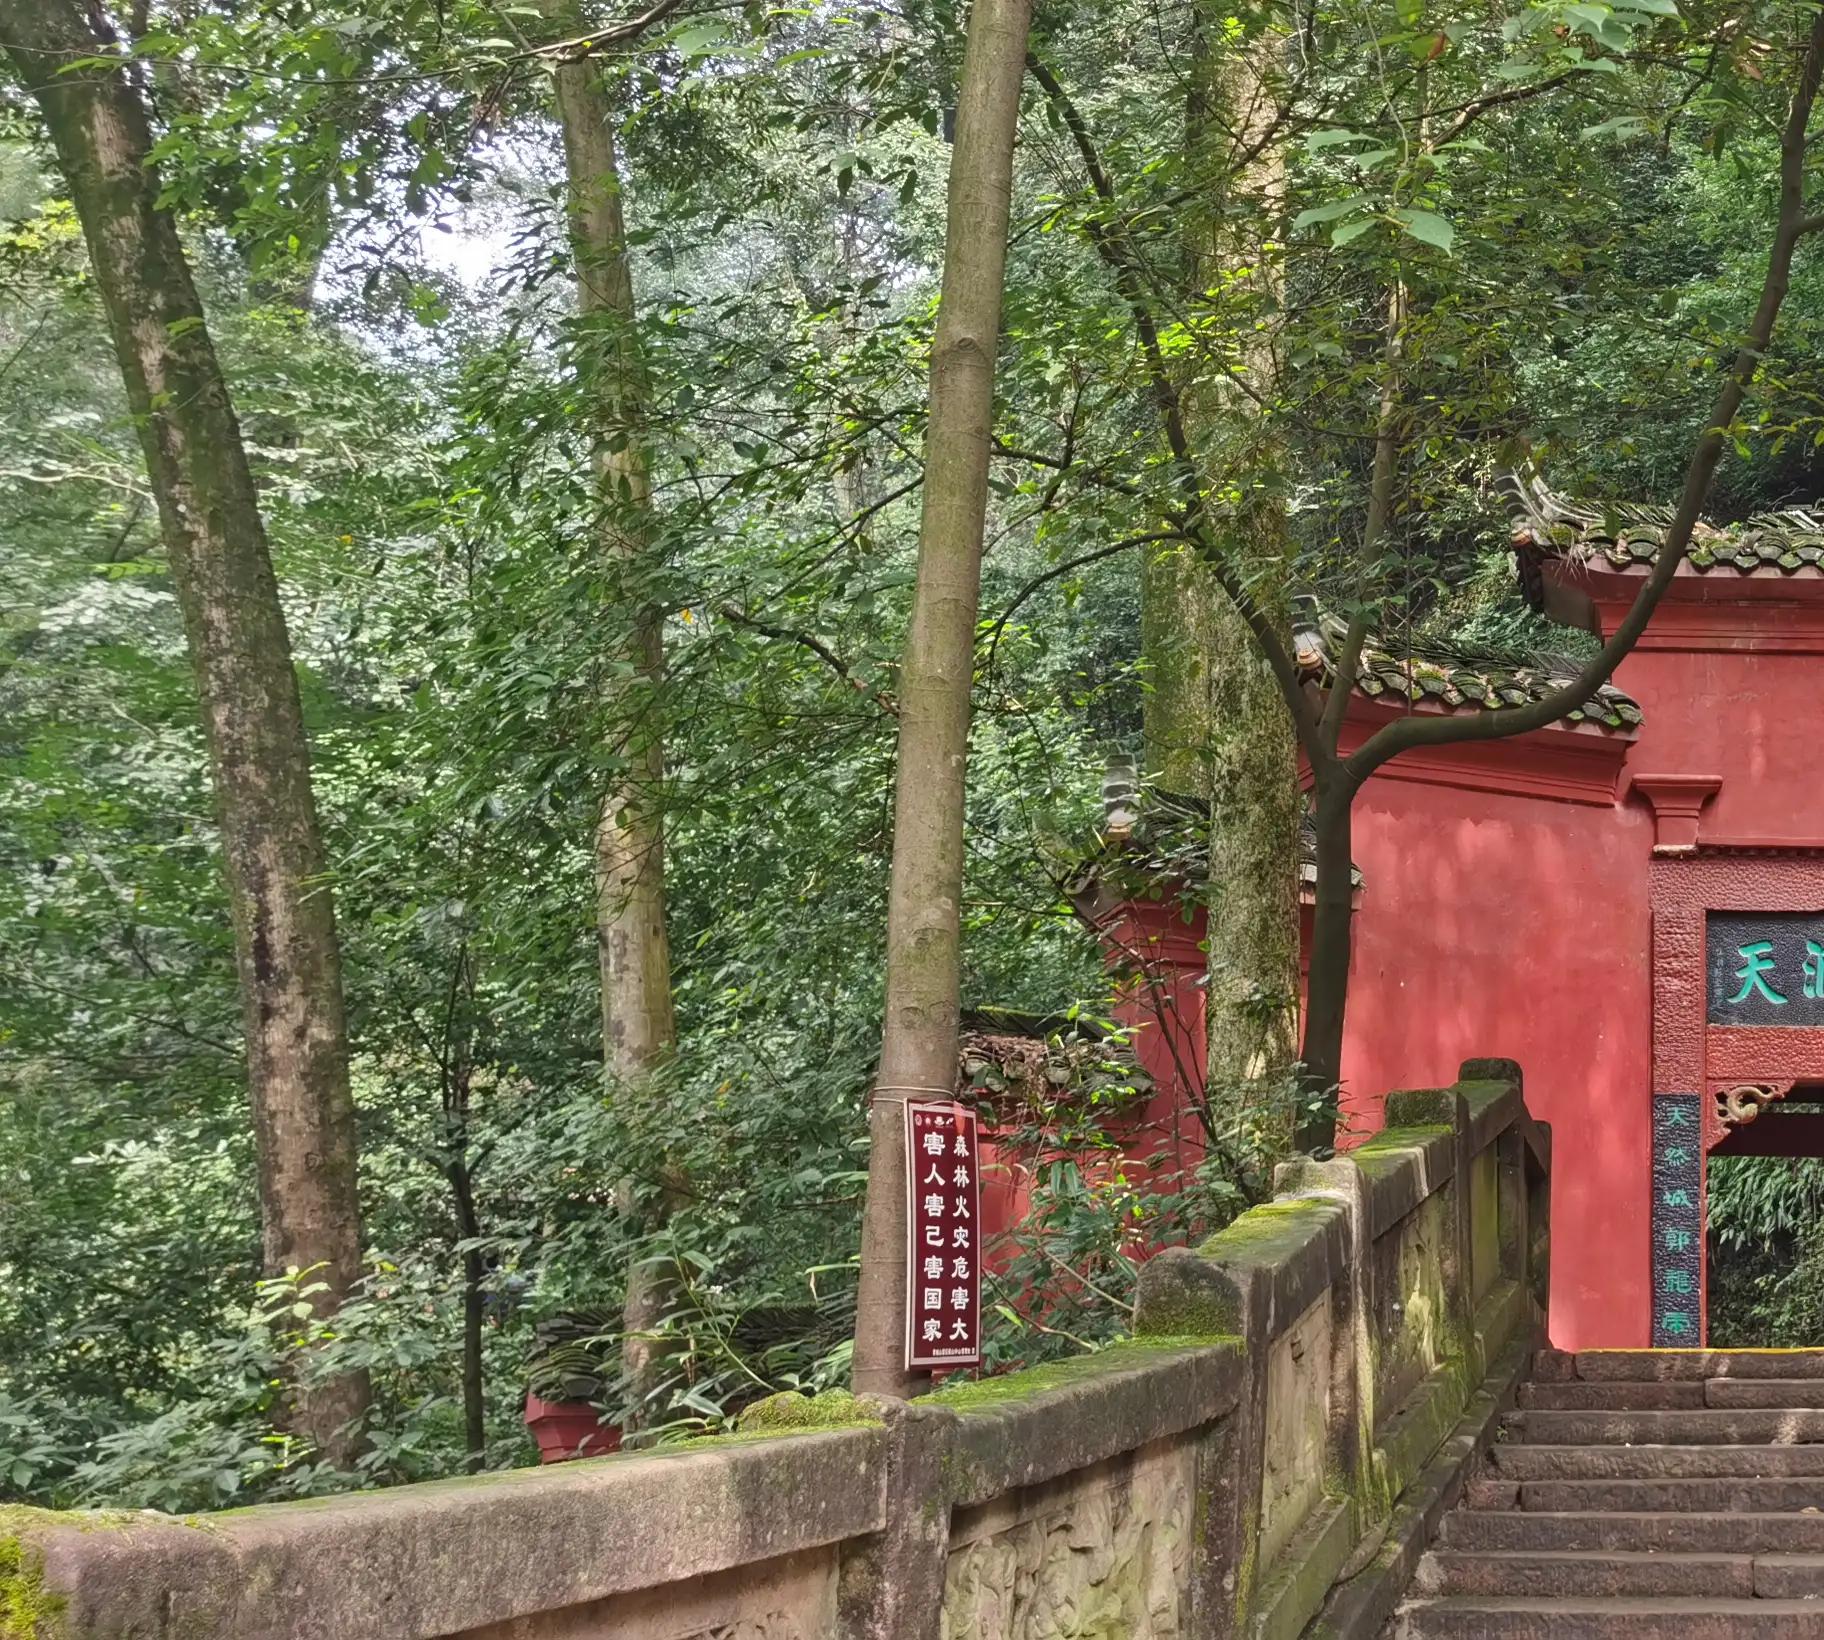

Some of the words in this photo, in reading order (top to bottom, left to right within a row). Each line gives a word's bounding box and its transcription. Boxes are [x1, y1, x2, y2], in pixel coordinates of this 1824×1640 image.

[922, 1131, 946, 1342] 害人害己害国家
[949, 1134, 970, 1341] 森林火灾危害大
